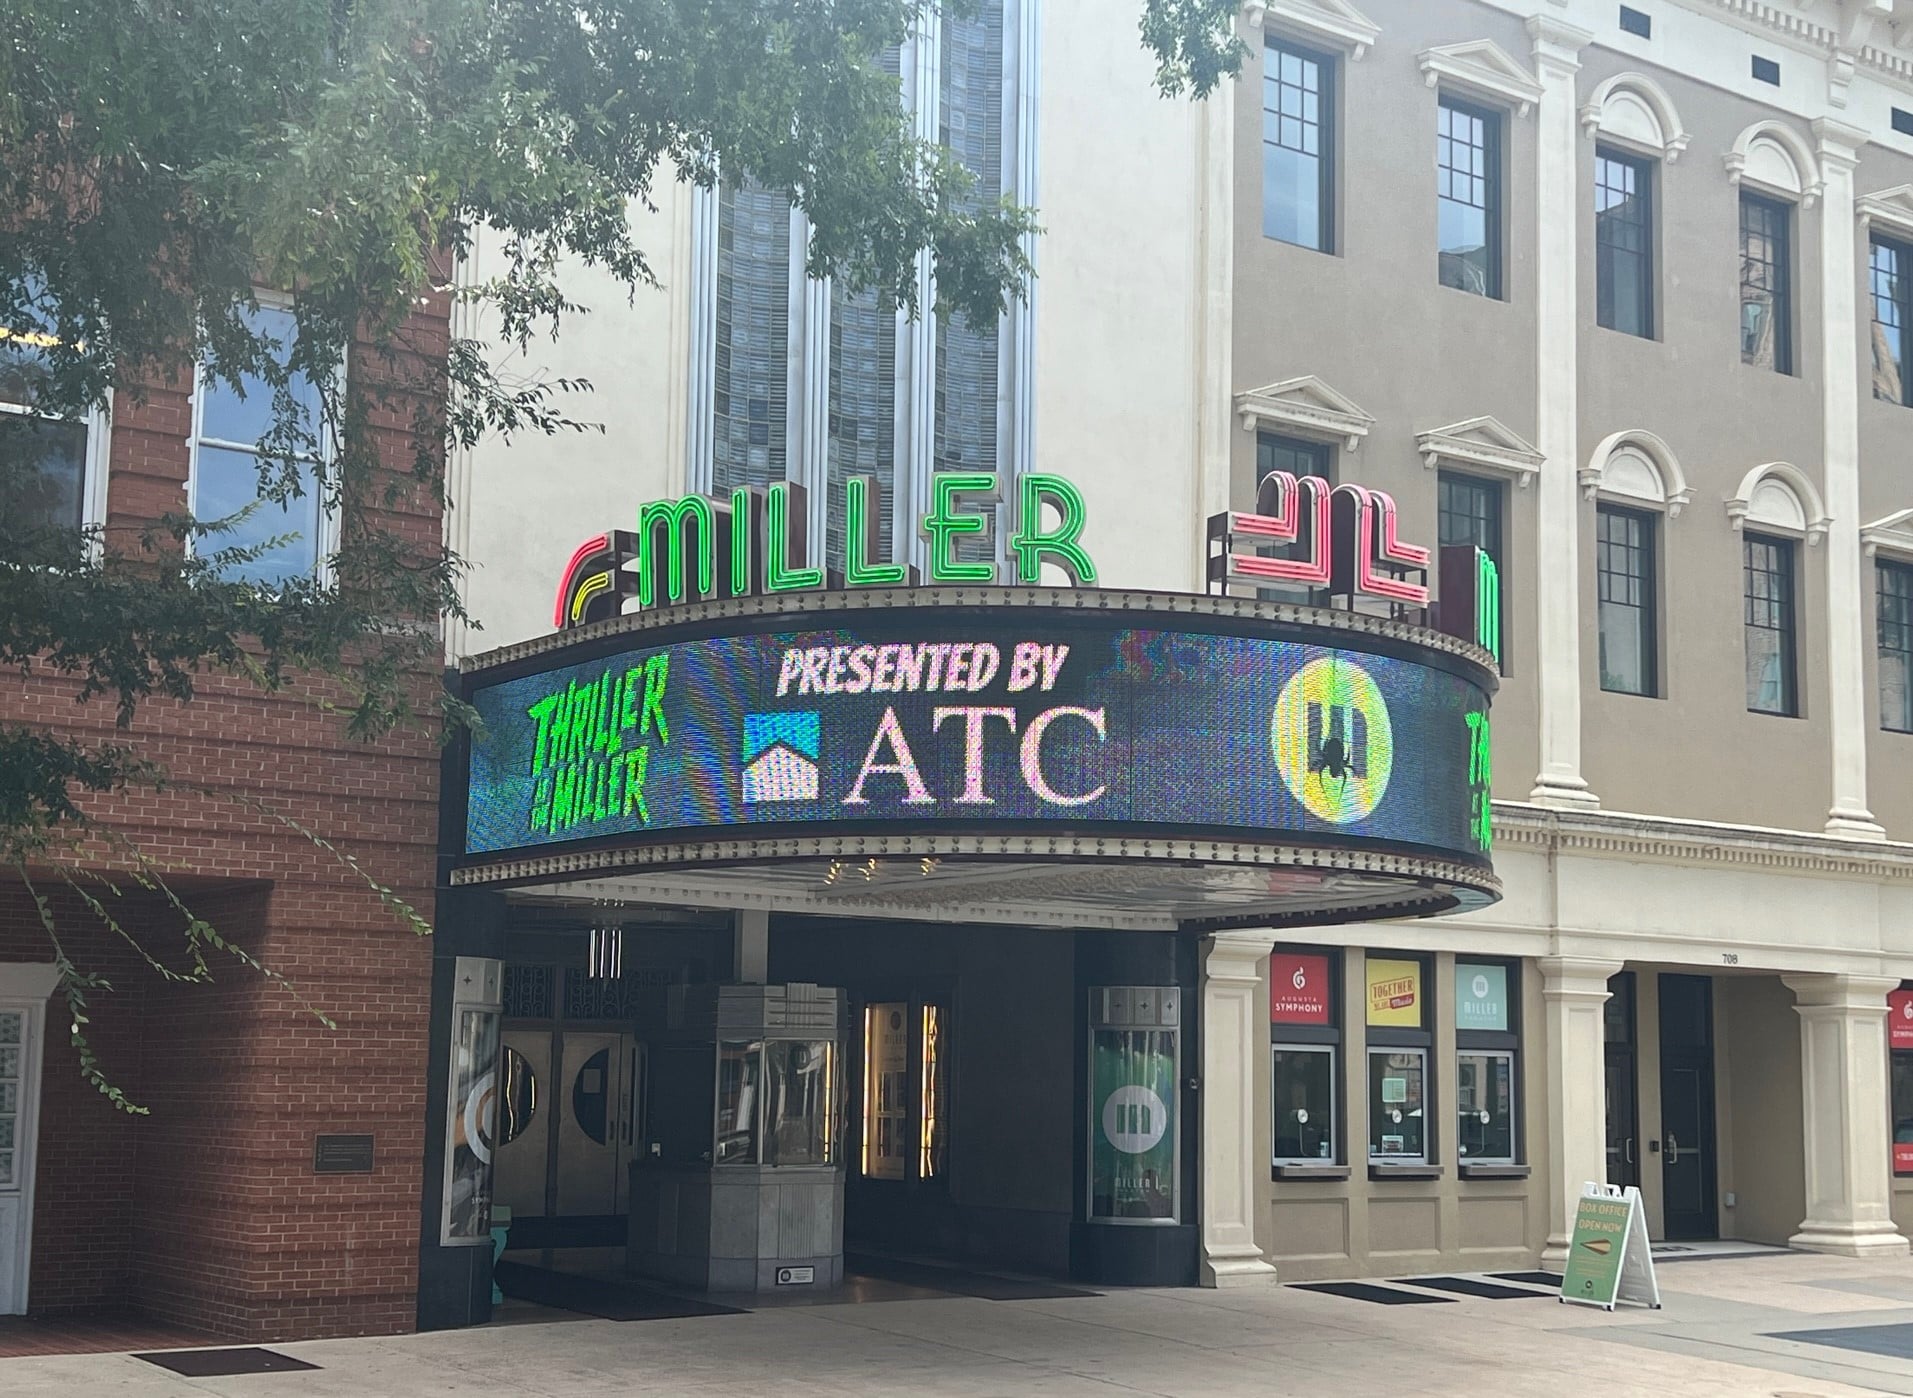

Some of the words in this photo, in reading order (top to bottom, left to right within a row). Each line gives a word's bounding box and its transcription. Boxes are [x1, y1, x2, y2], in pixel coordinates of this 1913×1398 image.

[775, 641, 1000, 697] PRESENTED
[1006, 641, 1070, 692] BY
[527, 652, 670, 778] THRILLER
[840, 704, 1106, 807] ATC
[549, 745, 650, 835] MILLER
[1722, 953, 1738, 965] 708
[1373, 979, 1413, 999] TOGETHER
[1275, 1003, 1323, 1013] SYMPHONY
[1579, 1202, 1597, 1213] BOX
[1599, 1203, 1628, 1217] OFFICE
[1578, 1219, 1601, 1231] OPEN
[1602, 1221, 1623, 1233] NOW
